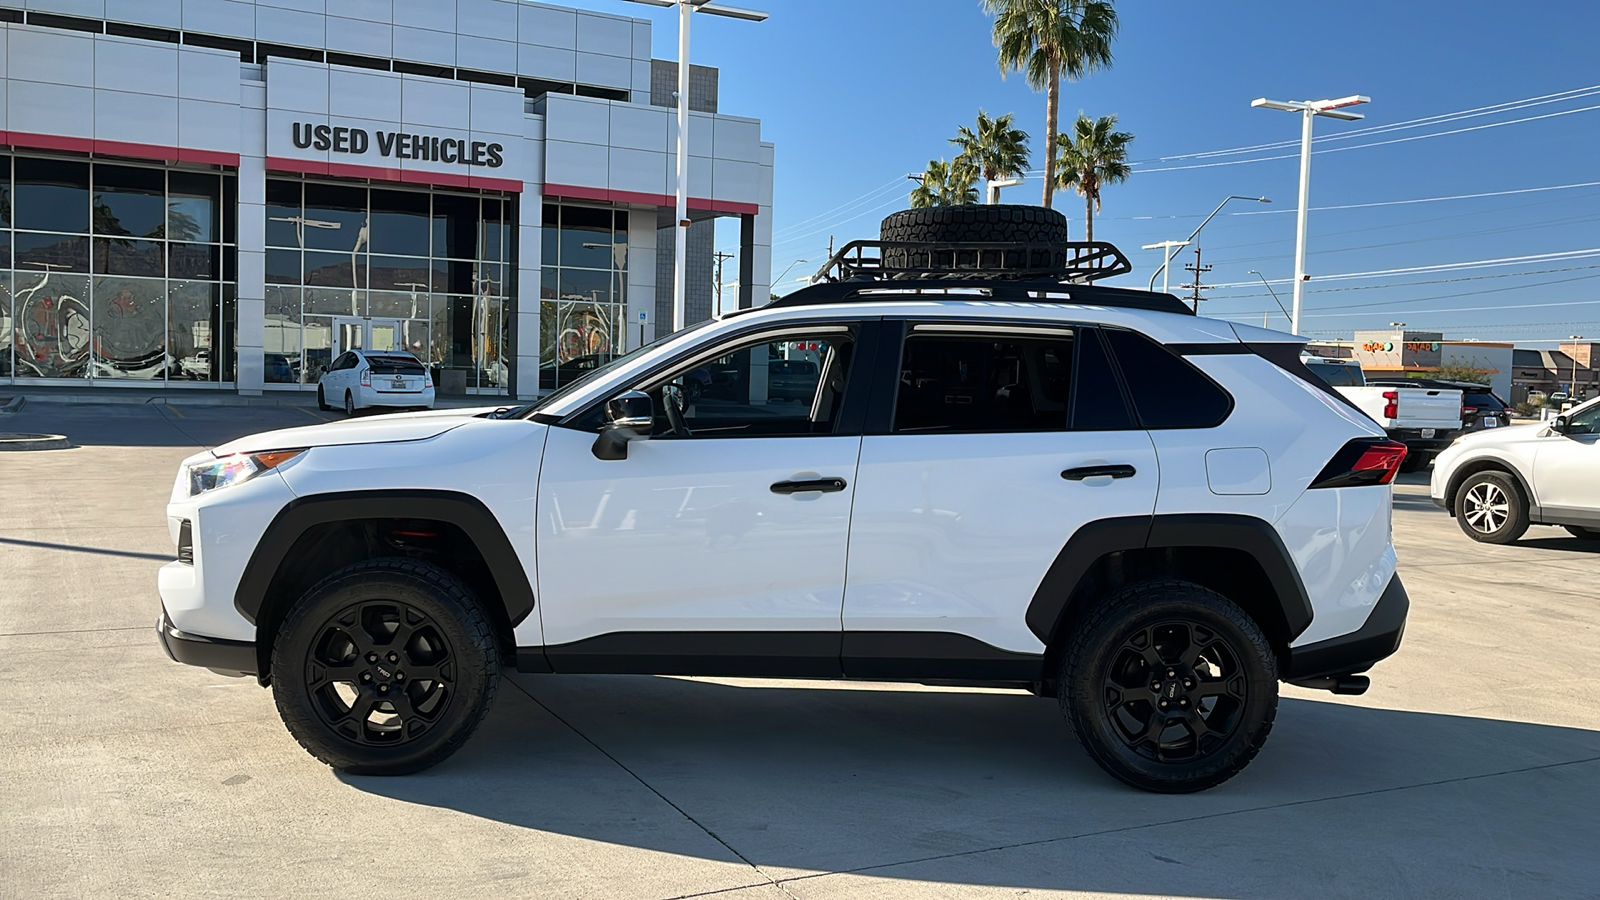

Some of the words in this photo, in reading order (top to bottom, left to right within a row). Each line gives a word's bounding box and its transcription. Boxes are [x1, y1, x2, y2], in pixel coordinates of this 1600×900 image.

[292, 122, 369, 154] USED
[376, 131, 504, 168] VEHICLES
[377, 666, 391, 678] TRD
